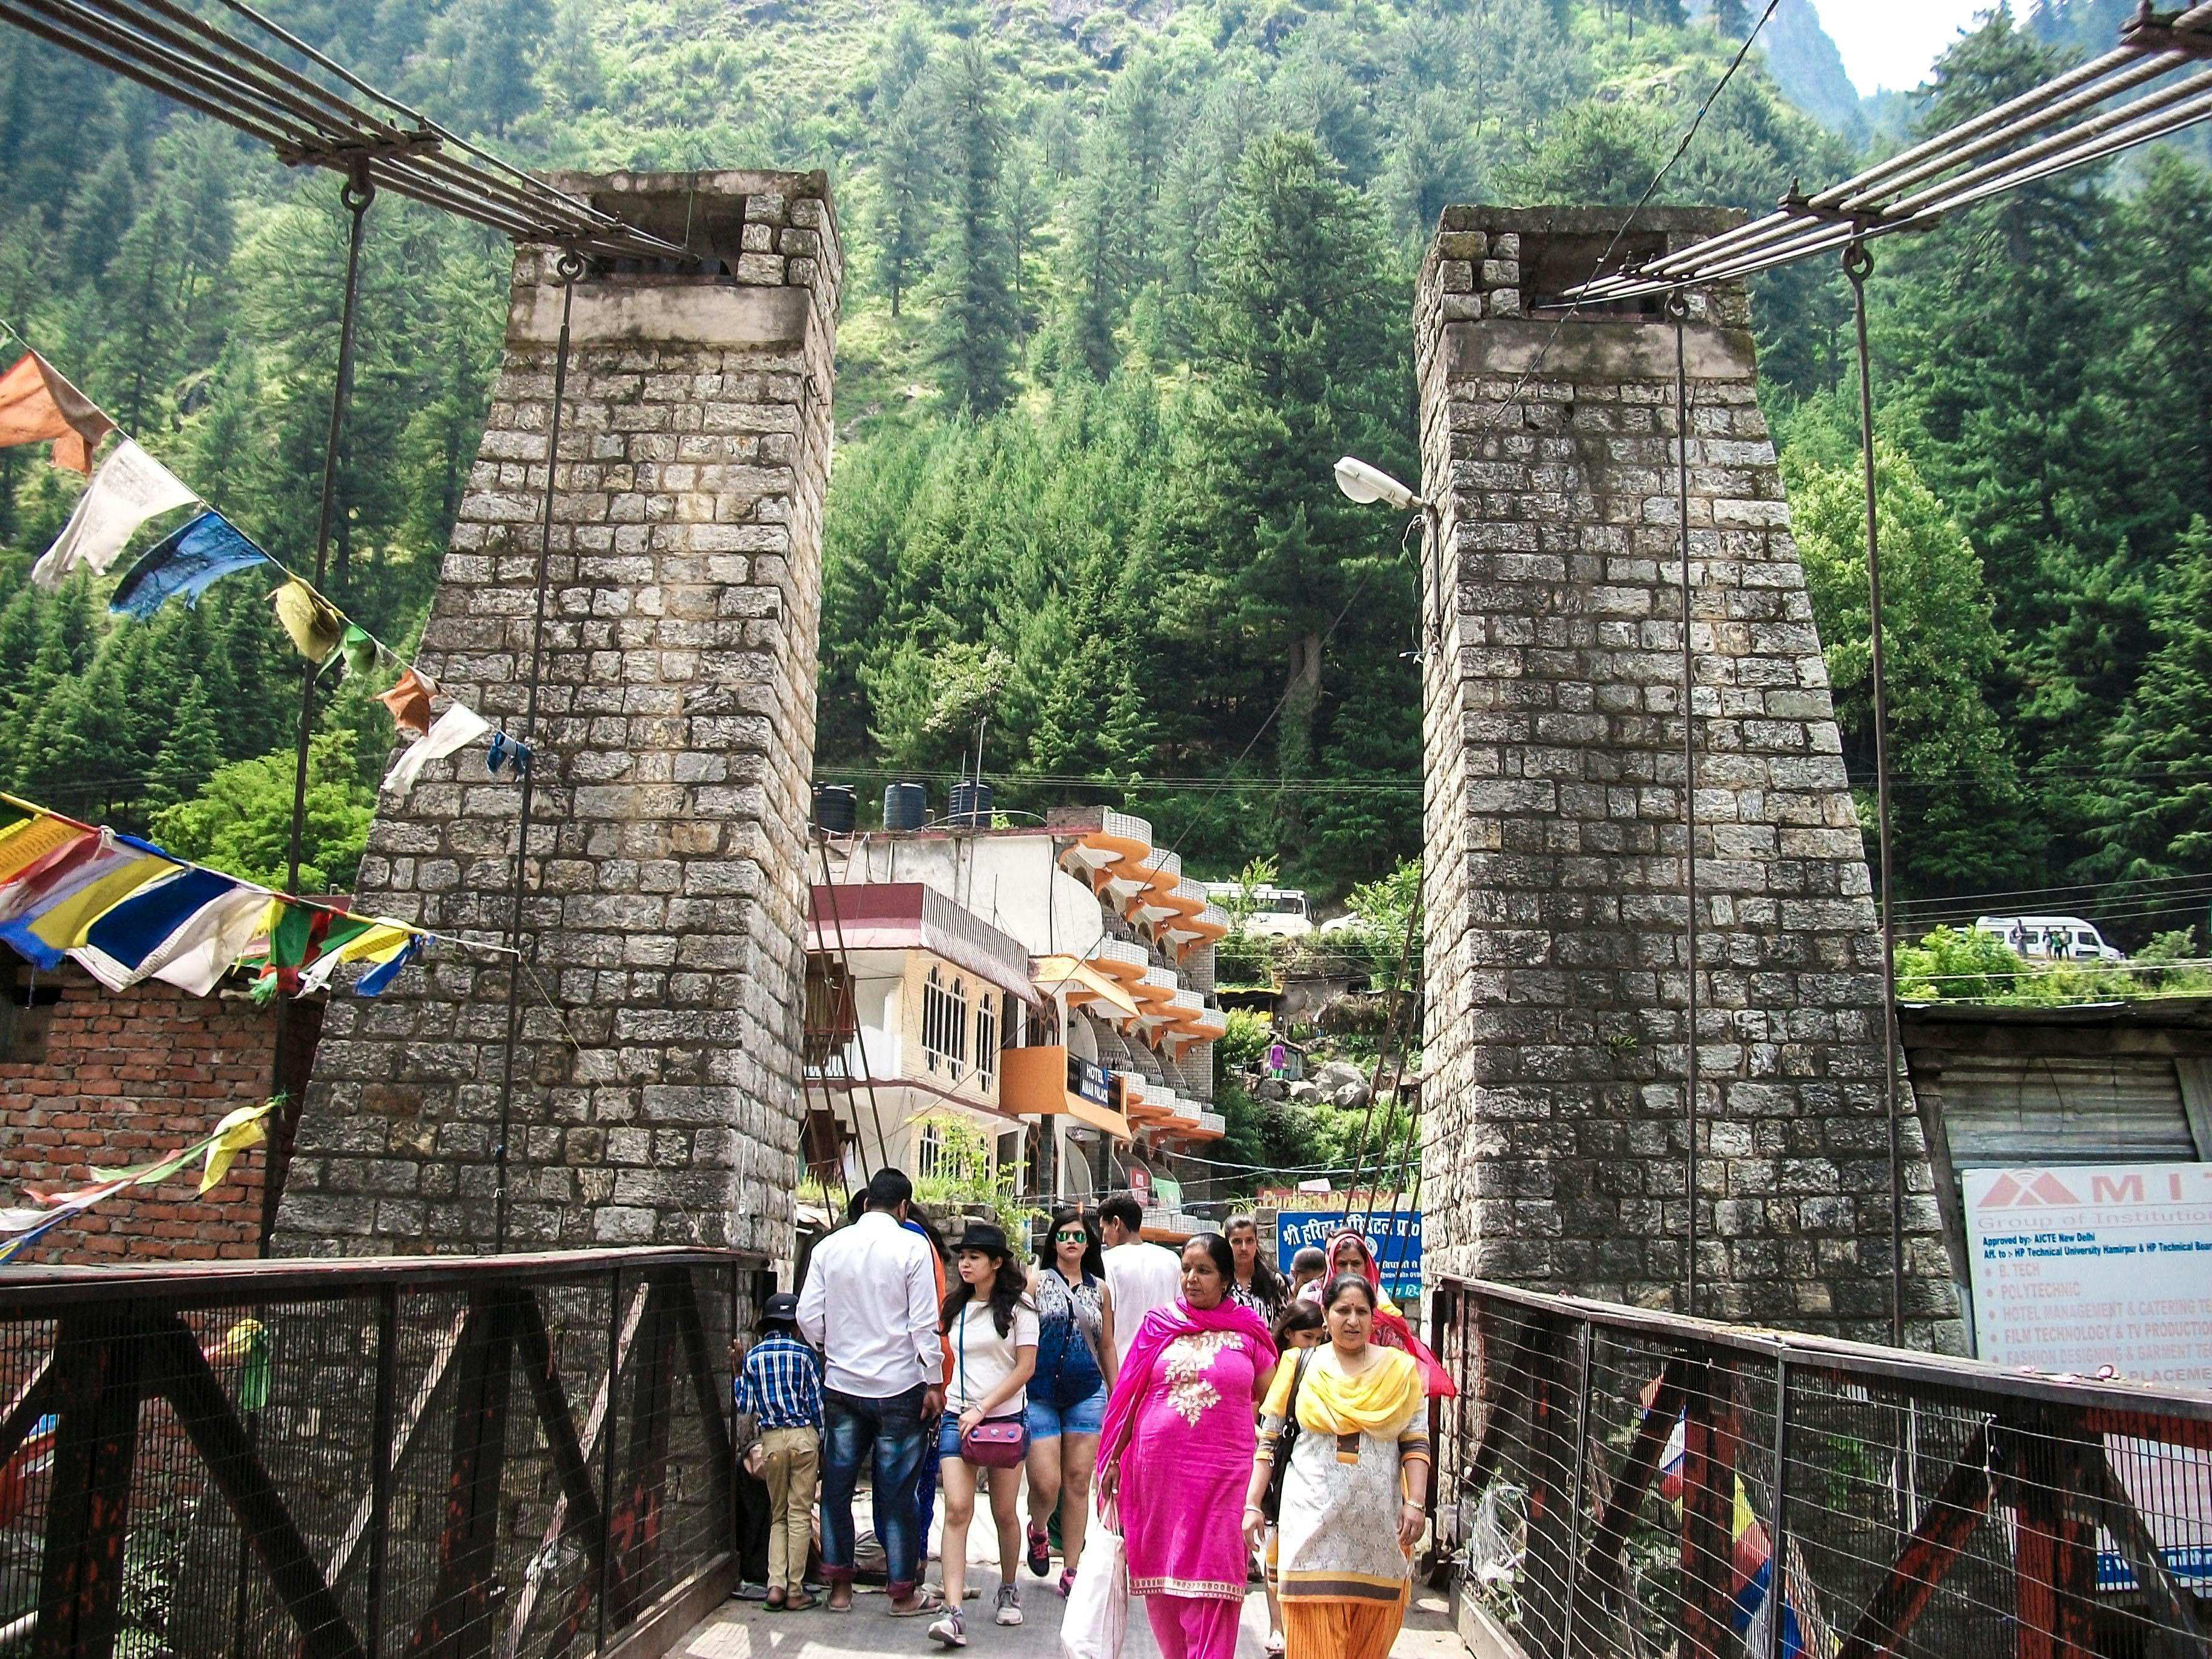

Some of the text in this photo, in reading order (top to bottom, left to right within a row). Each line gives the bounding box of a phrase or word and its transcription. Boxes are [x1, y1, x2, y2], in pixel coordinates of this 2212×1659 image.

[1086, 1063, 1104, 1085] HOTEL
[1978, 1216, 2053, 1229] Group
[2062, 1213, 2086, 1225] of
[1282, 1223, 1301, 1246] श्री
[1983, 1235, 2017, 1247] Approved
[2034, 1233, 2057, 1243] AICTE
[2058, 1233, 2075, 1242] New
[2076, 1232, 2095, 1241] Delhi
[2014, 1248, 2025, 1257] HP
[2027, 1247, 2062, 1256] Technical
[2064, 1245, 2101, 1257] University
[2138, 1242, 2144, 1253] &
[2146, 1242, 2156, 1252] HP
[2158, 1241, 2193, 1251] Technical
[2012, 1262, 2041, 1277] TECH
[2001, 1280, 2080, 1299] POLYTECHNIC
[2003, 1305, 2041, 1321] HOTEL
[2043, 1302, 2123, 1320] MANAGEMENT
[2127, 1300, 2135, 1315] &
[2138, 1299, 2196, 1315] CATERING
[2004, 1328, 2031, 1343] FILM
[2033, 1324, 2111, 1342] TECHNOLOGY
[2115, 1323, 2124, 1339] &
[2126, 1323, 2141, 1339] TV
[2006, 1349, 2057, 1366] FASHION
[2060, 1346, 2123, 1364] DESIGNING
[2126, 1346, 2134, 1361] &
[2137, 1343, 2192, 1360] GARMENT
